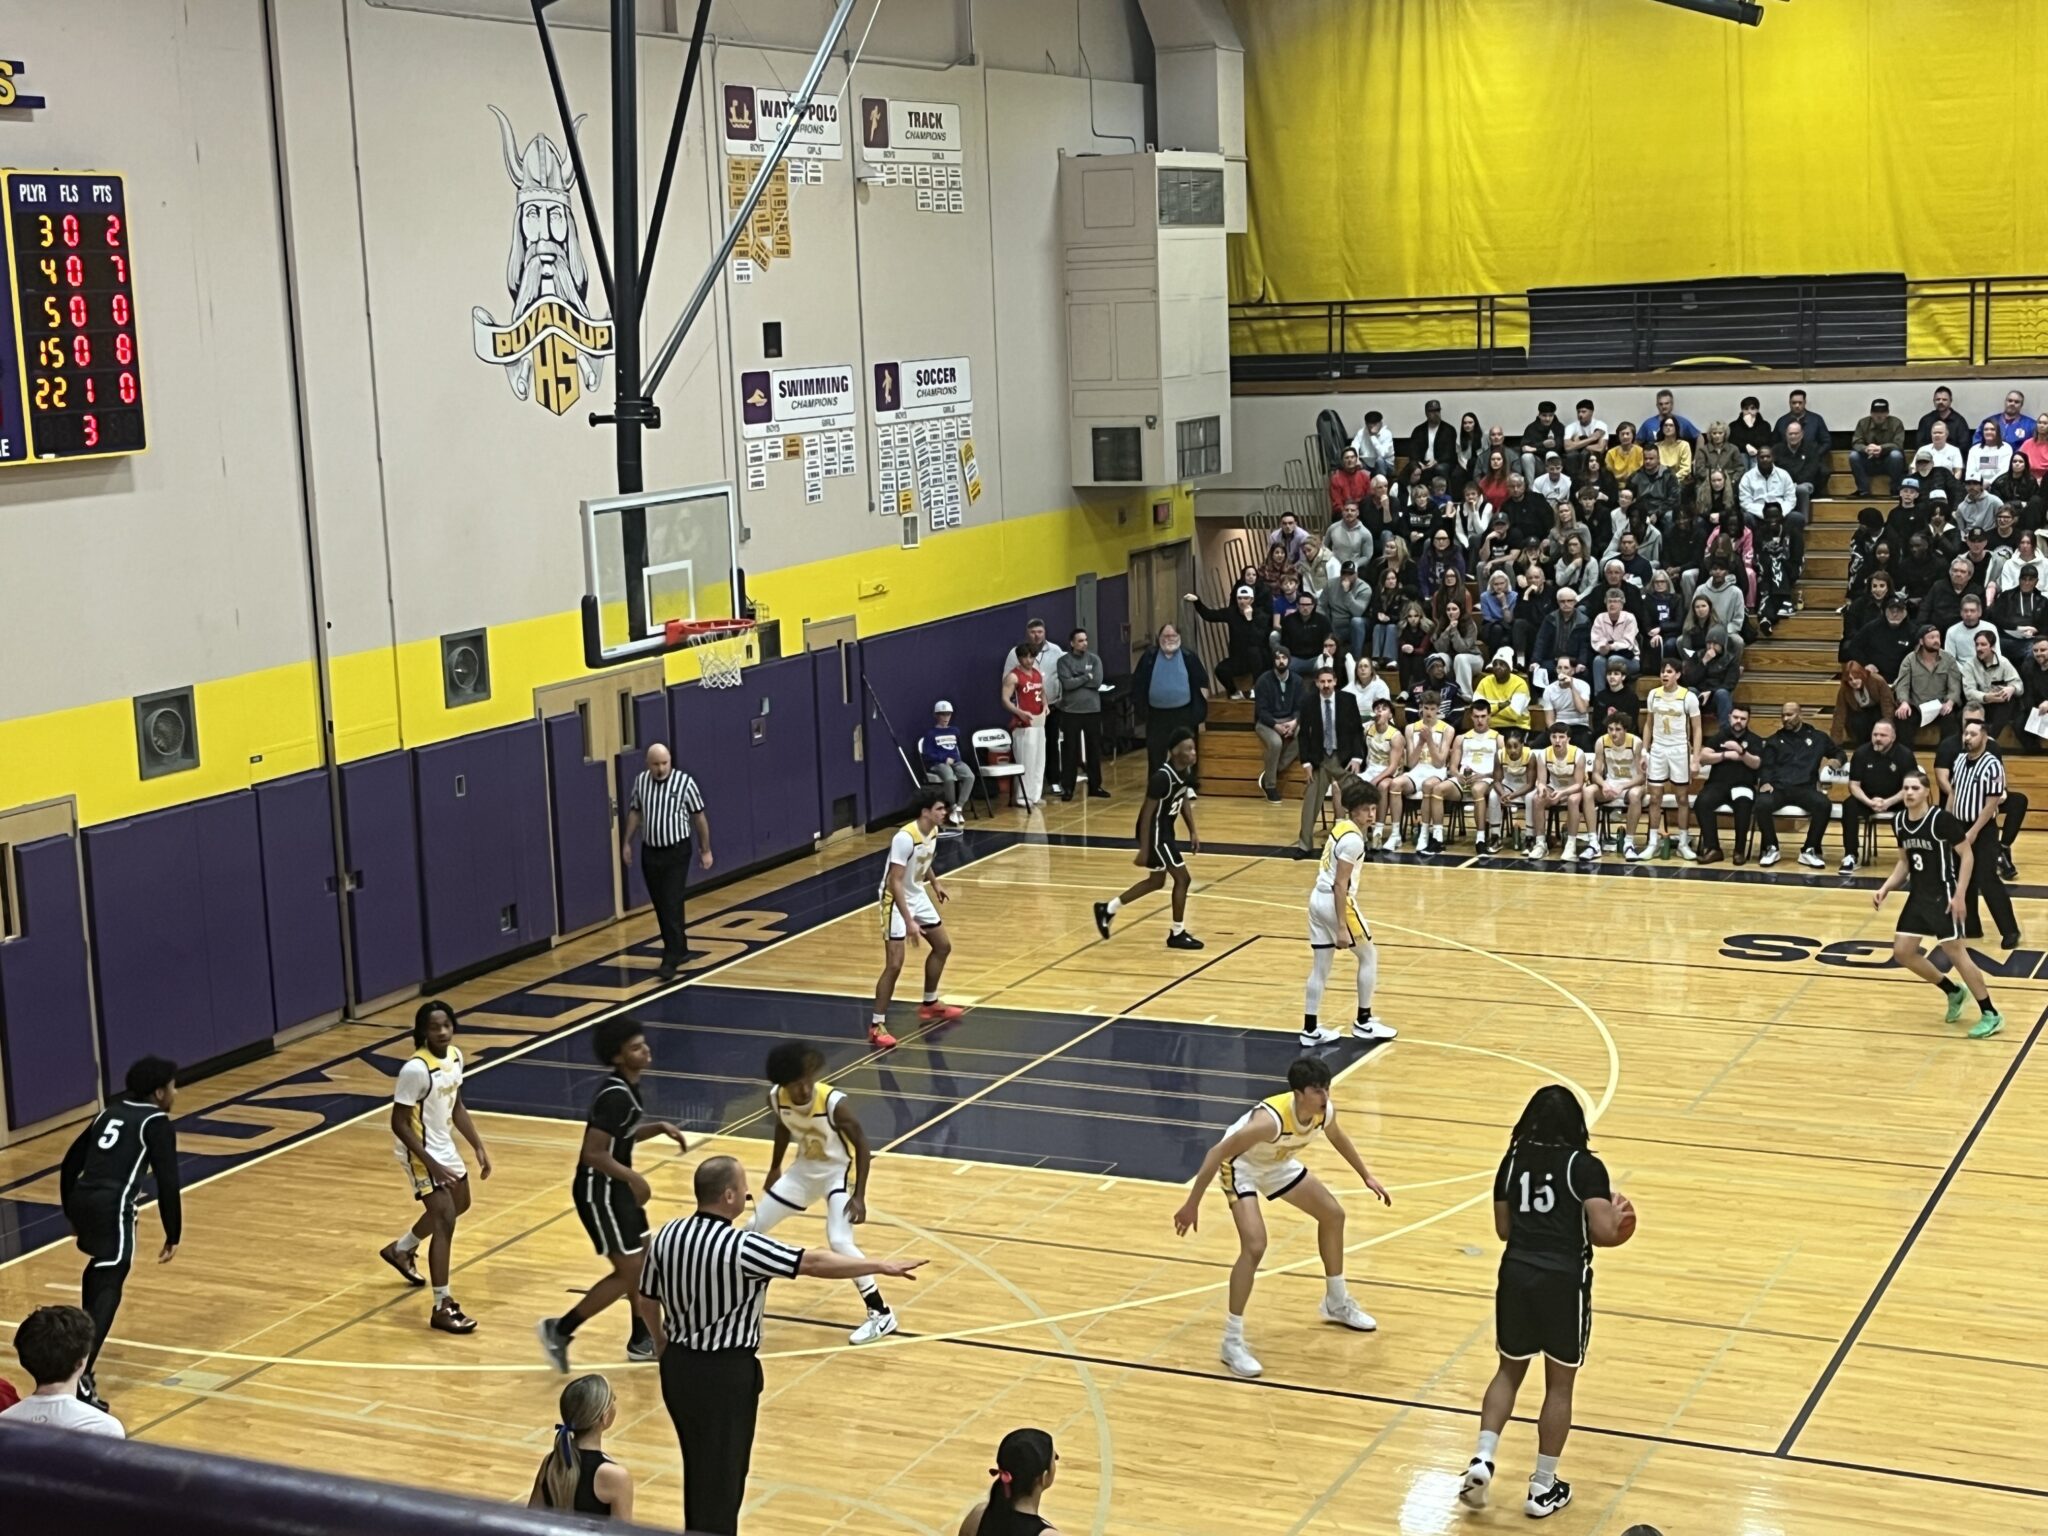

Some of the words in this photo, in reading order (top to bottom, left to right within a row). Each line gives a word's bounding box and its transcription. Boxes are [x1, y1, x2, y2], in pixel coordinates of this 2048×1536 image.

[808, 104, 837, 122] POLO
[908, 112, 942, 129] TRACK
[905, 131, 946, 141] CHAMPIONS
[19, 184, 47, 202] PLYR
[60, 185, 79, 203] FLS
[92, 185, 112, 203] PTS
[39, 215, 53, 247] 3
[63, 215, 78, 247] 0
[107, 215, 120, 246] 2
[41, 259, 57, 284] 4
[66, 255, 82, 286] 0
[111, 256, 125, 283] 7
[45, 296, 61, 327] 5
[70, 295, 86, 327] 0
[113, 294, 128, 325] 0
[495, 302, 609, 357] PUYALLUP
[40, 337, 64, 368] 15
[74, 335, 90, 366] 0
[116, 333, 131, 364] 8
[533, 334, 580, 416] HS
[778, 375, 849, 399] SWIMMING
[916, 368, 956, 386] SOCCER
[36, 376, 67, 409] 22
[87, 378, 94, 403] 1
[119, 372, 135, 404] 0
[791, 397, 838, 410] CHAMPIONS
[916, 386, 957, 399] CHAMPIONS
[84, 415, 98, 446] 3
[978, 734, 1005, 742] VIKINGS
[1912, 853, 1923, 872] 3
[99, 1119, 124, 1149] 5
[1519, 1171, 1555, 1213] 15
